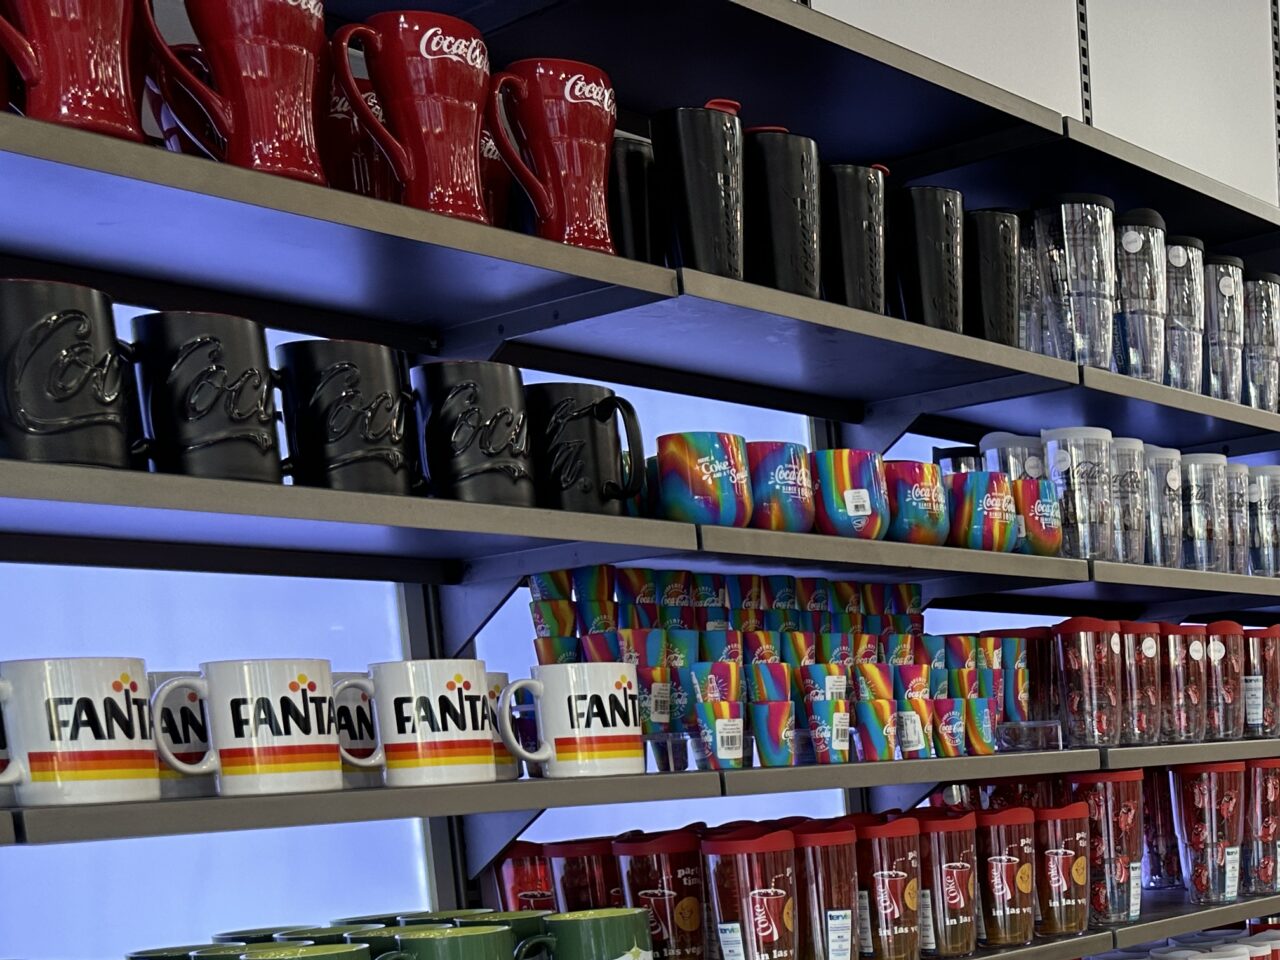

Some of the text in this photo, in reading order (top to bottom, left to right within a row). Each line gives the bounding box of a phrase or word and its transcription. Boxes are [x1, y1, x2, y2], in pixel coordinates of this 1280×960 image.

[46, 688, 152, 741] FANT
[567, 687, 641, 729] FANT
[755, 903, 773, 937] Coke
